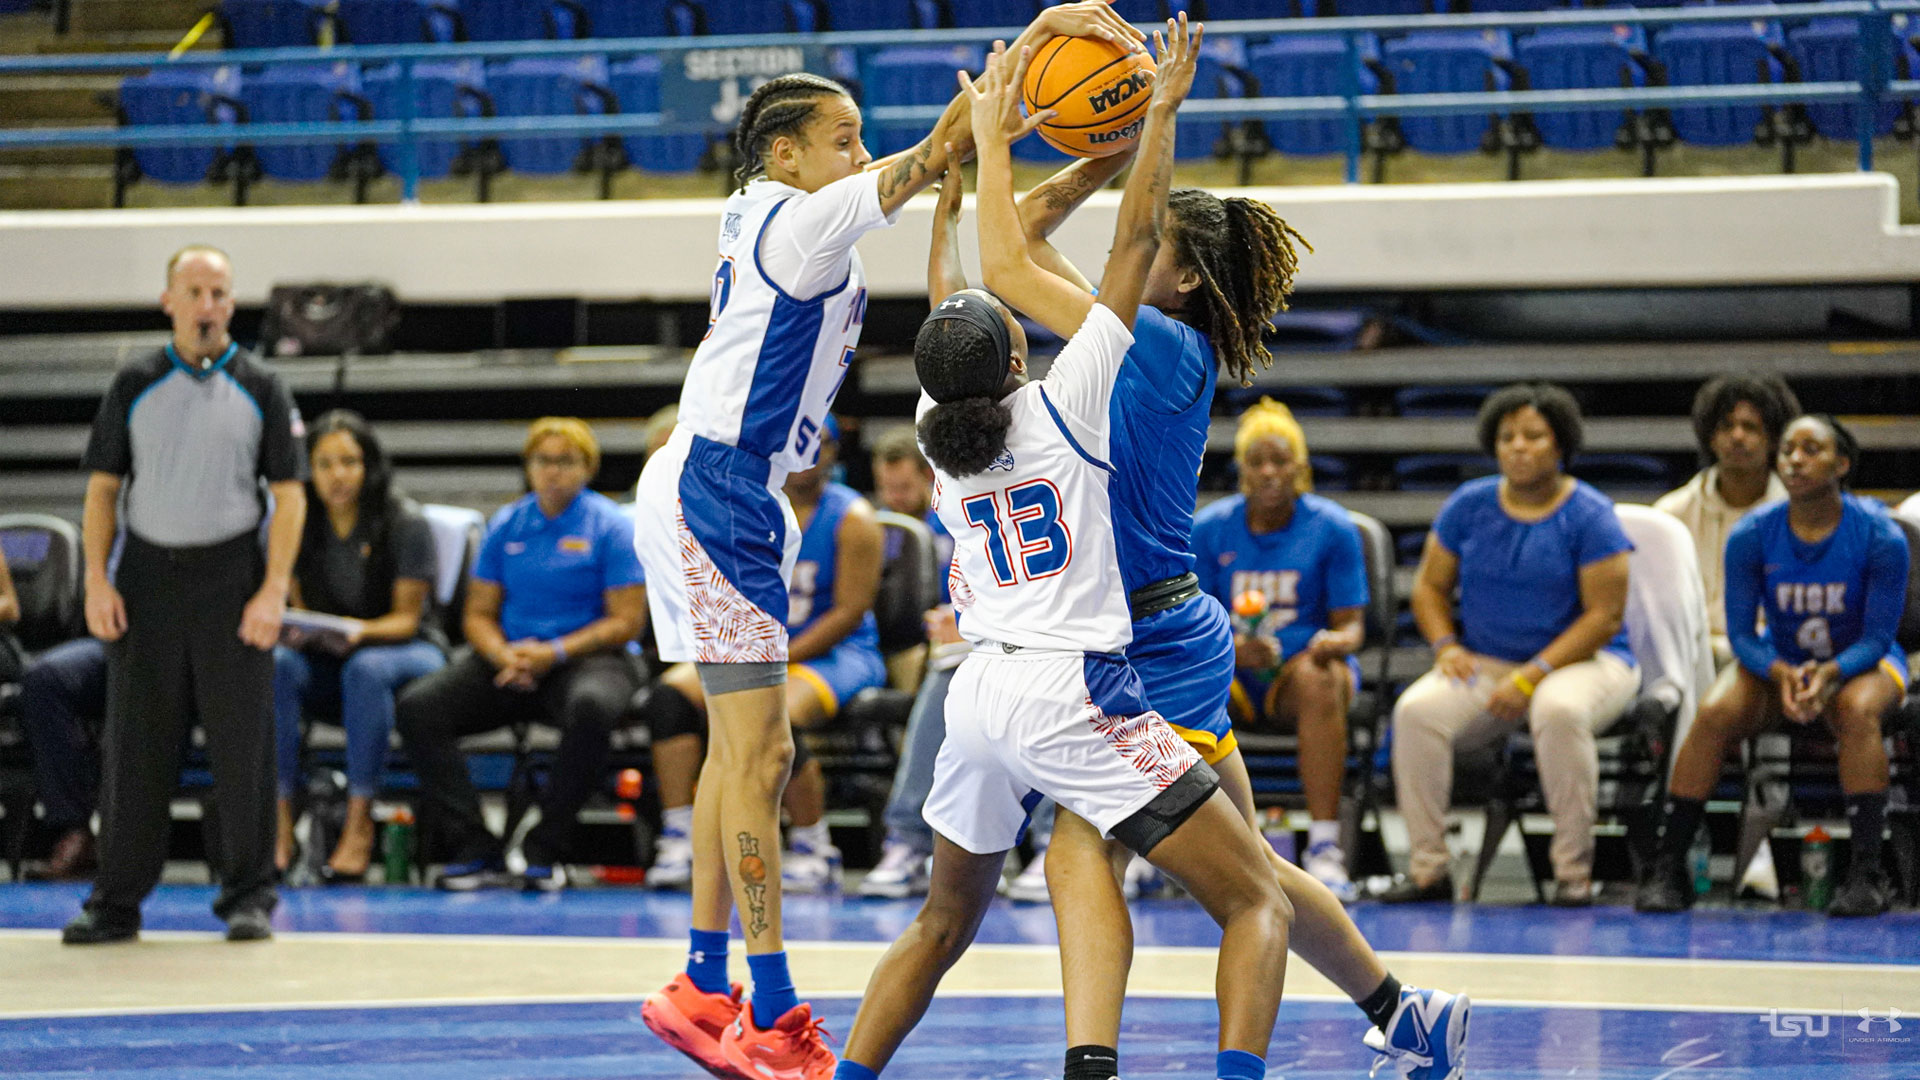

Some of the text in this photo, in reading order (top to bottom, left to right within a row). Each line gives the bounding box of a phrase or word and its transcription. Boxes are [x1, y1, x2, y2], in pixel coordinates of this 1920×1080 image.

[684, 48, 804, 80] SECTION
[1088, 72, 1147, 115] NCAA
[961, 478, 1072, 588] 13
